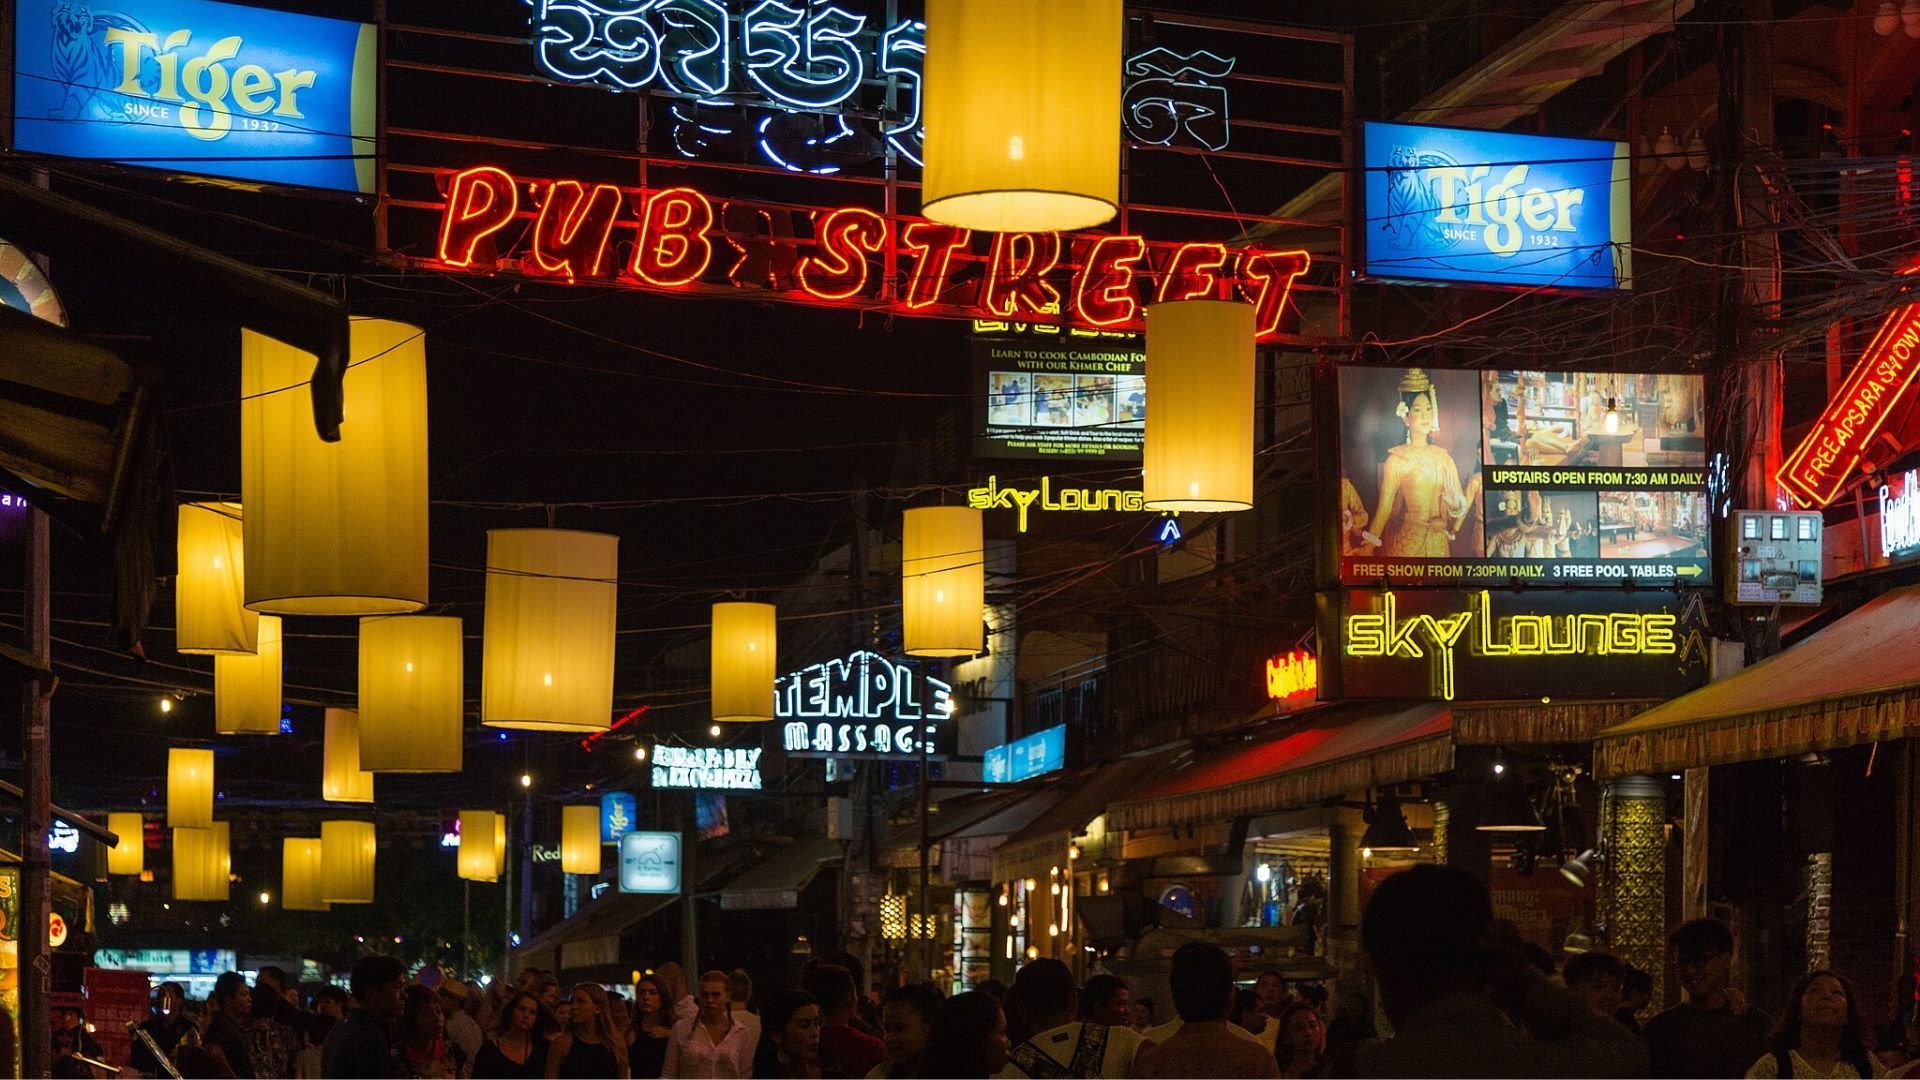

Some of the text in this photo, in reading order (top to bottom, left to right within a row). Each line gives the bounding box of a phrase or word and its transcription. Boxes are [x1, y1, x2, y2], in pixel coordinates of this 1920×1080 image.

[104, 27, 317, 141] Tiger
[125, 102, 280, 133] SINCE 1932
[1426, 162, 1585, 257] Tiger
[440, 166, 1311, 336] PUB STREET
[1443, 229, 1559, 246] SINCE 1932
[991, 348, 1146, 363] LEARN TO COOK CAMBODIAN FO
[1018, 360, 1132, 372] WITH OUR KHMER CHEF
[1834, 380, 1886, 447] APSARA
[1042, 476, 1147, 511] LOUNG
[1492, 471, 1704, 486] UPSTAIRS OPEN FROM 7:30 AM DAILY.
[1353, 564, 1545, 577] FREE SHOW FROM 7:30PM DAILY.
[1553, 565, 1677, 577] 3 FREE POOL TABLES.
[1348, 591, 1473, 700] SKY
[1481, 590, 1676, 655] LOUNGE
[774, 650, 952, 720] TEMPLE
[784, 721, 936, 754] MASSAGE
[532, 844, 561, 862] Red
